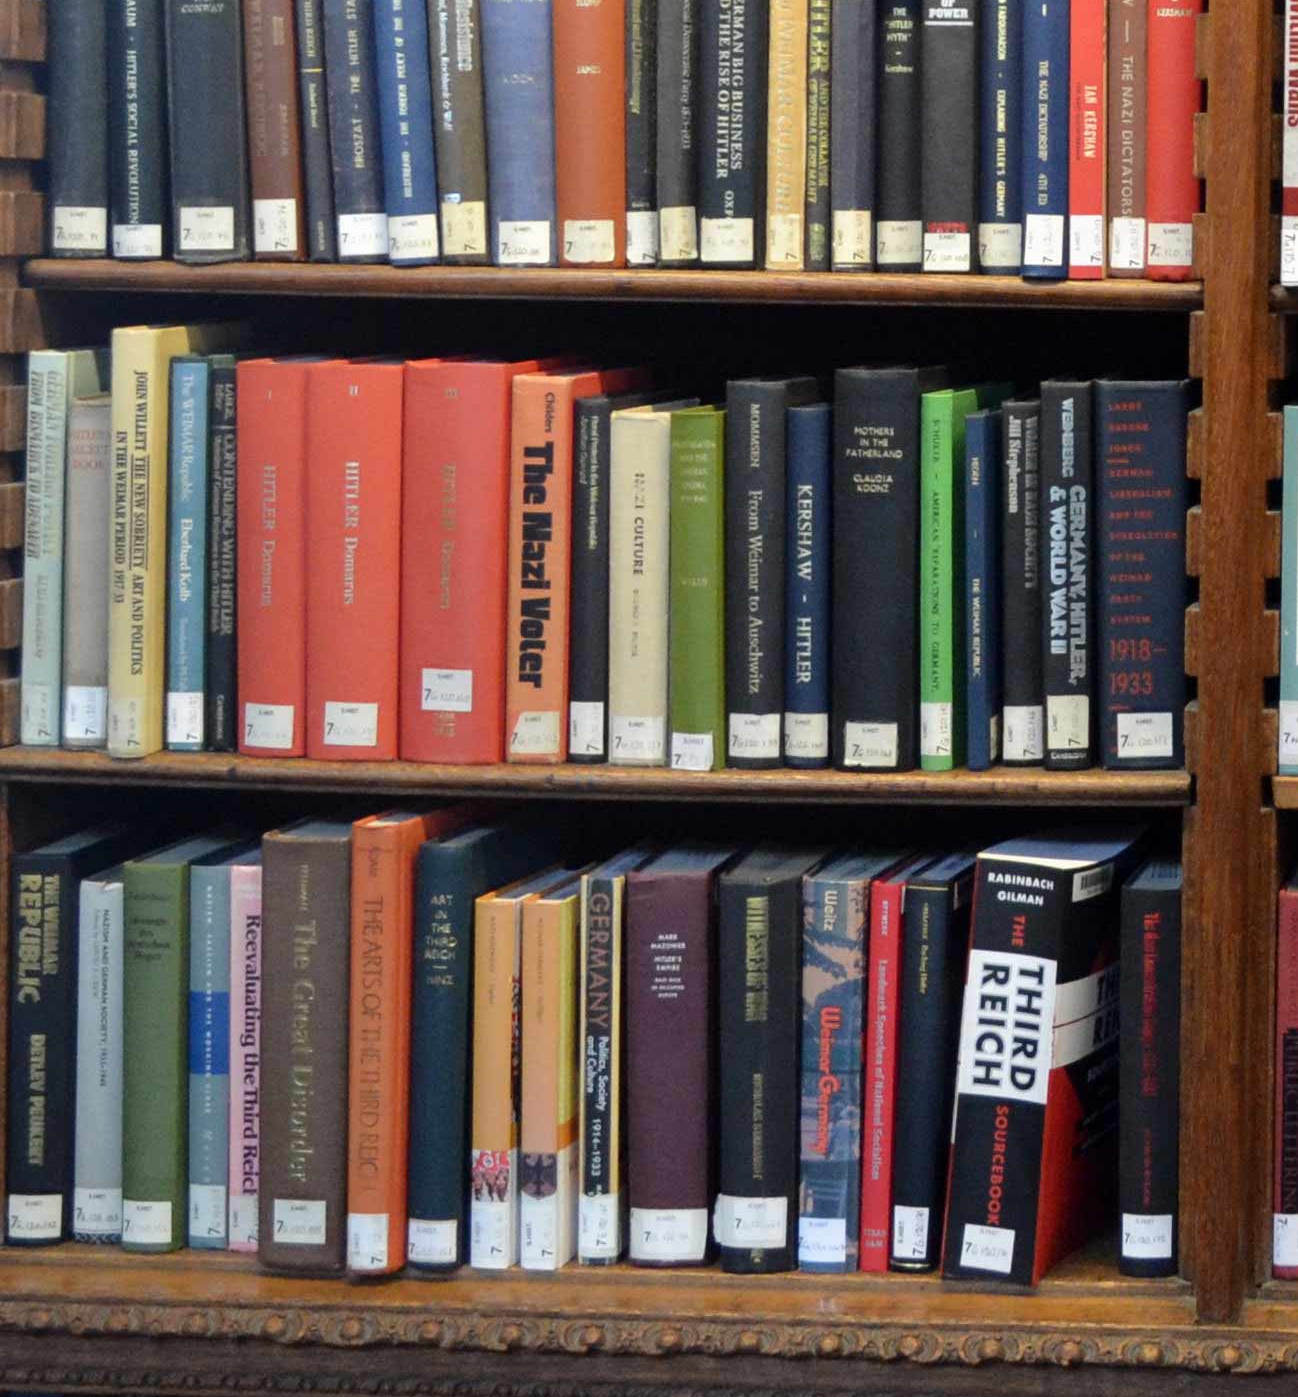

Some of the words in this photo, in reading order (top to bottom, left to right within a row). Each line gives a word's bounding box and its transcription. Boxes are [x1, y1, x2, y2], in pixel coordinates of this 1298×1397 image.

[718, 12, 731, 44] THE
[929, 8, 968, 18] POWER
[718, 50, 731, 84] RISE
[732, 58, 744, 84] BIG
[717, 89, 730, 109] OF
[716, 113, 730, 178] HITLER
[730, 86, 743, 171] BUSINESS
[846, 448, 903, 459] FATHERLAND
[854, 426, 895, 437] MOTHERS
[860, 438, 871, 447] IN
[875, 438, 890, 447] THE
[522, 441, 555, 505] The
[521, 512, 552, 589] Nazi
[798, 485, 813, 580] KERSHAW
[1051, 507, 1066, 585] WORLD
[1051, 588, 1066, 637] WAR
[519, 598, 552, 688] Voter
[796, 616, 812, 684] HITLER
[1110, 674, 1152, 694] 1933
[988, 872, 1054, 890] RABINBACH
[997, 891, 1043, 905] GILMAN
[822, 890, 838, 932] Weitz
[1012, 915, 1025, 946] THE
[18, 875, 41, 1004] REPUBLIC
[591, 893, 610, 1029] GERMANY
[239, 914, 261, 1046] Reevaluating
[972, 964, 1008, 1086] REICH
[1010, 966, 1045, 1092] THIRD
[243, 1051, 260, 1084] the
[242, 1087, 259, 1138] Third
[986, 1106, 1008, 1226] SOURCEBOOK
